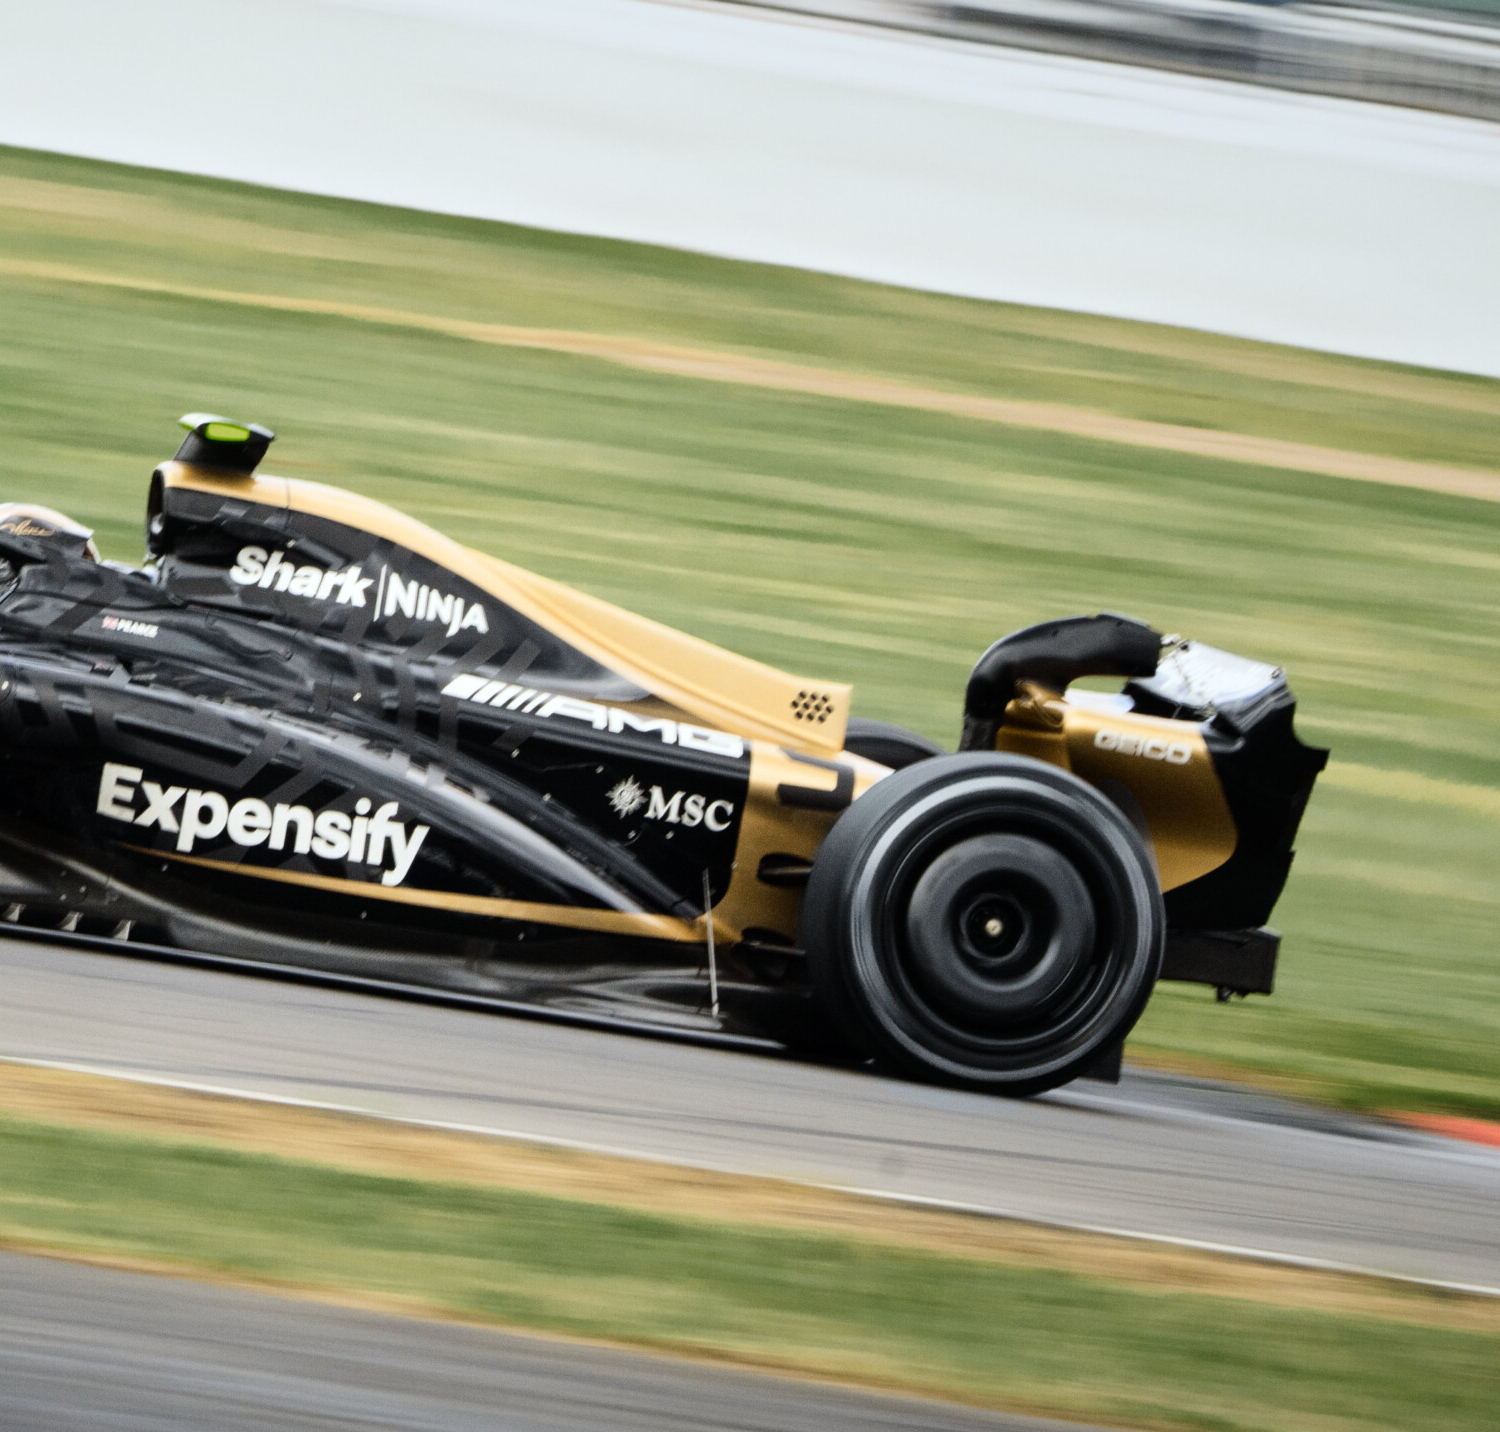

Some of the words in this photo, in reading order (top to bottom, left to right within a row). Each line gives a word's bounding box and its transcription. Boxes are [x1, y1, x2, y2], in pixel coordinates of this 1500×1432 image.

[229, 545, 374, 608] Shark
[535, 694, 744, 758] AMG
[1094, 729, 1192, 765] GEICO
[97, 762, 430, 887] Expensify
[644, 785, 734, 832] MSC
